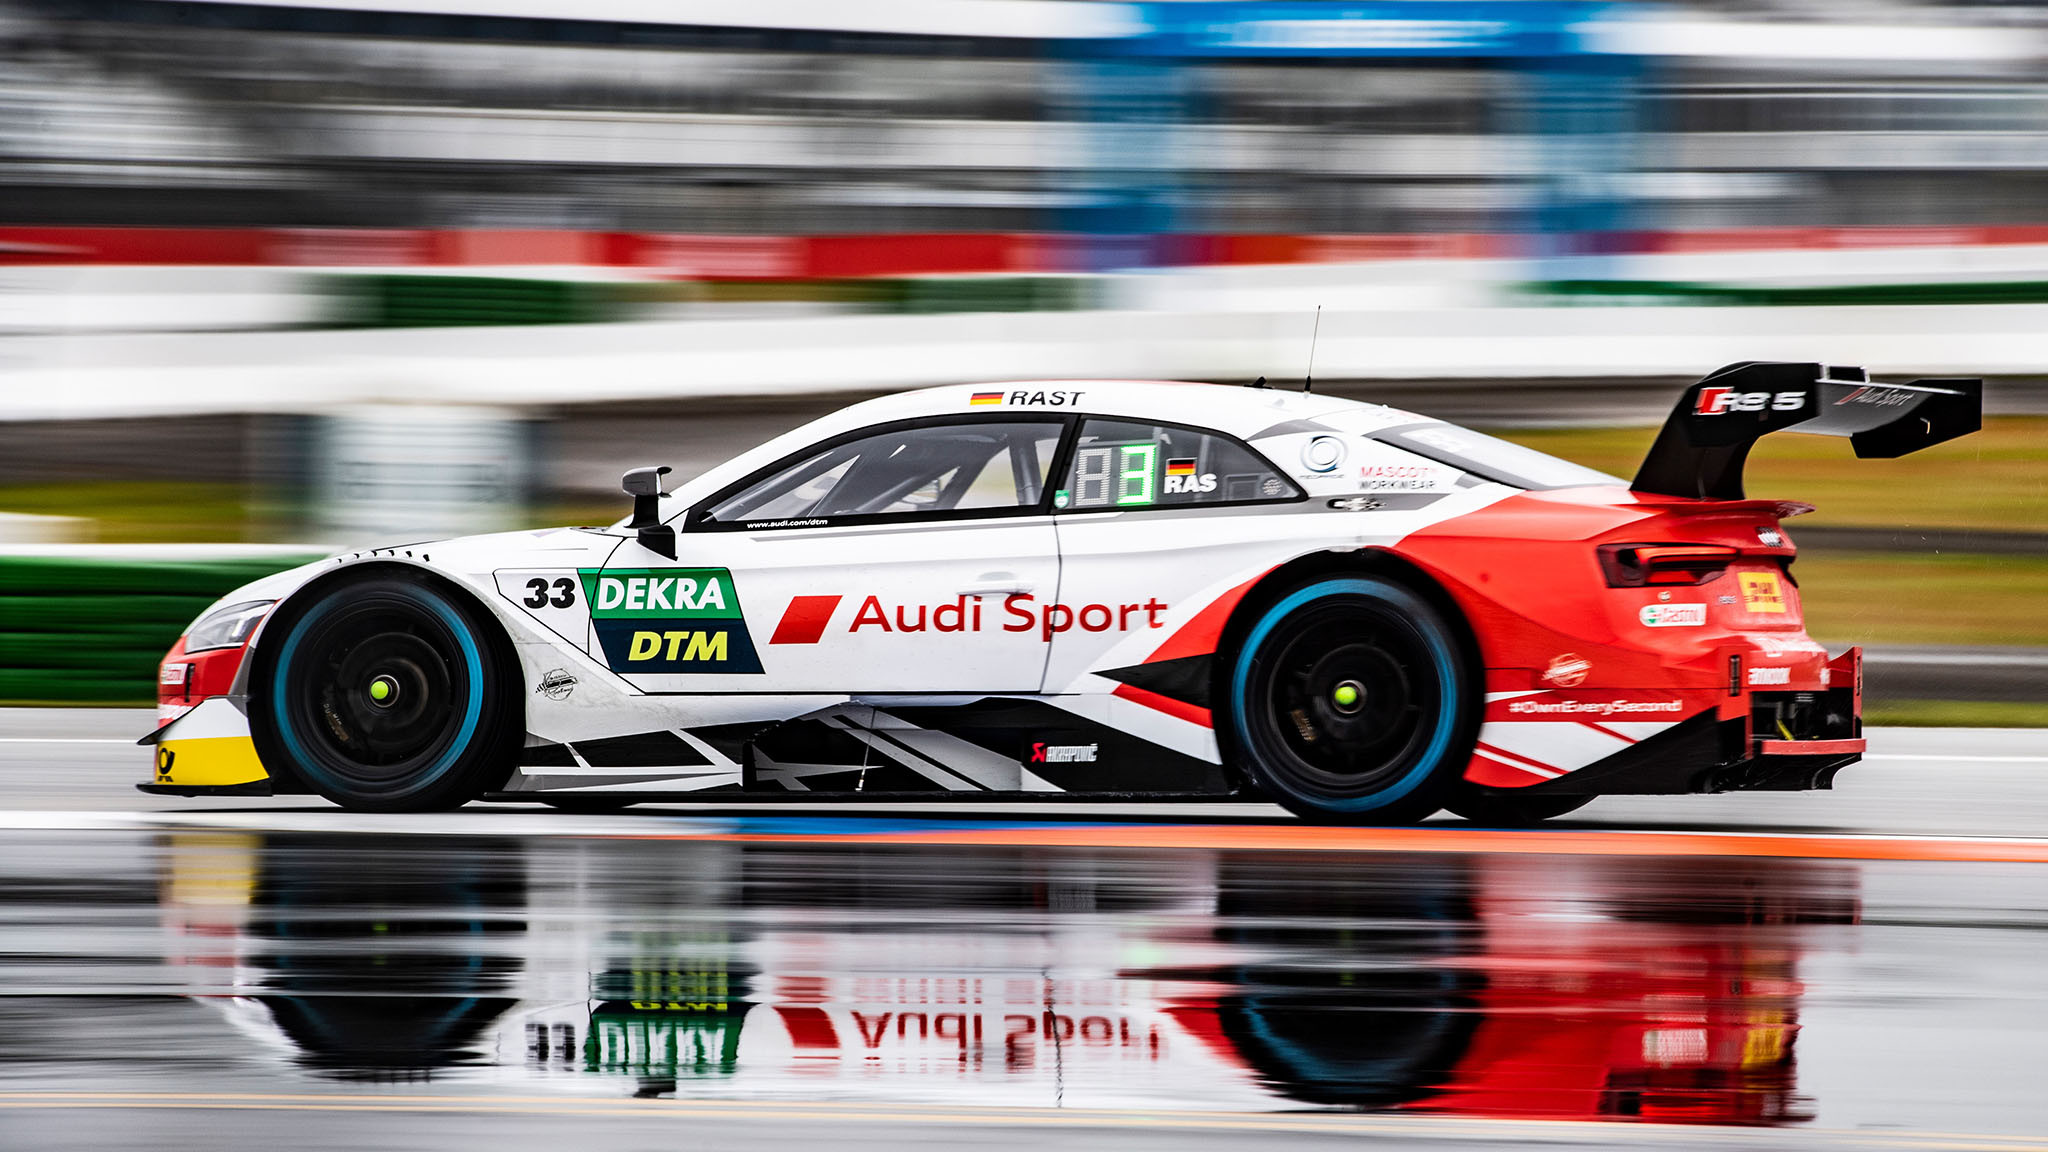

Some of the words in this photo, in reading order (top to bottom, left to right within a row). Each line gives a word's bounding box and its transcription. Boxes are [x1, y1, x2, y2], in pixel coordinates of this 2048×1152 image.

[1009, 391, 1086, 406] RAST
[1772, 391, 1806, 411] 5
[1163, 473, 1217, 494] RAS
[746, 519, 828, 529] www.audi.com/dtm
[523, 578, 576, 609] 33
[597, 577, 726, 610] DEKRA
[848, 594, 983, 633] Audi
[1003, 593, 1168, 642] Sport
[628, 631, 728, 661] DTM
[1508, 699, 1683, 716] #OwnEverySecond
